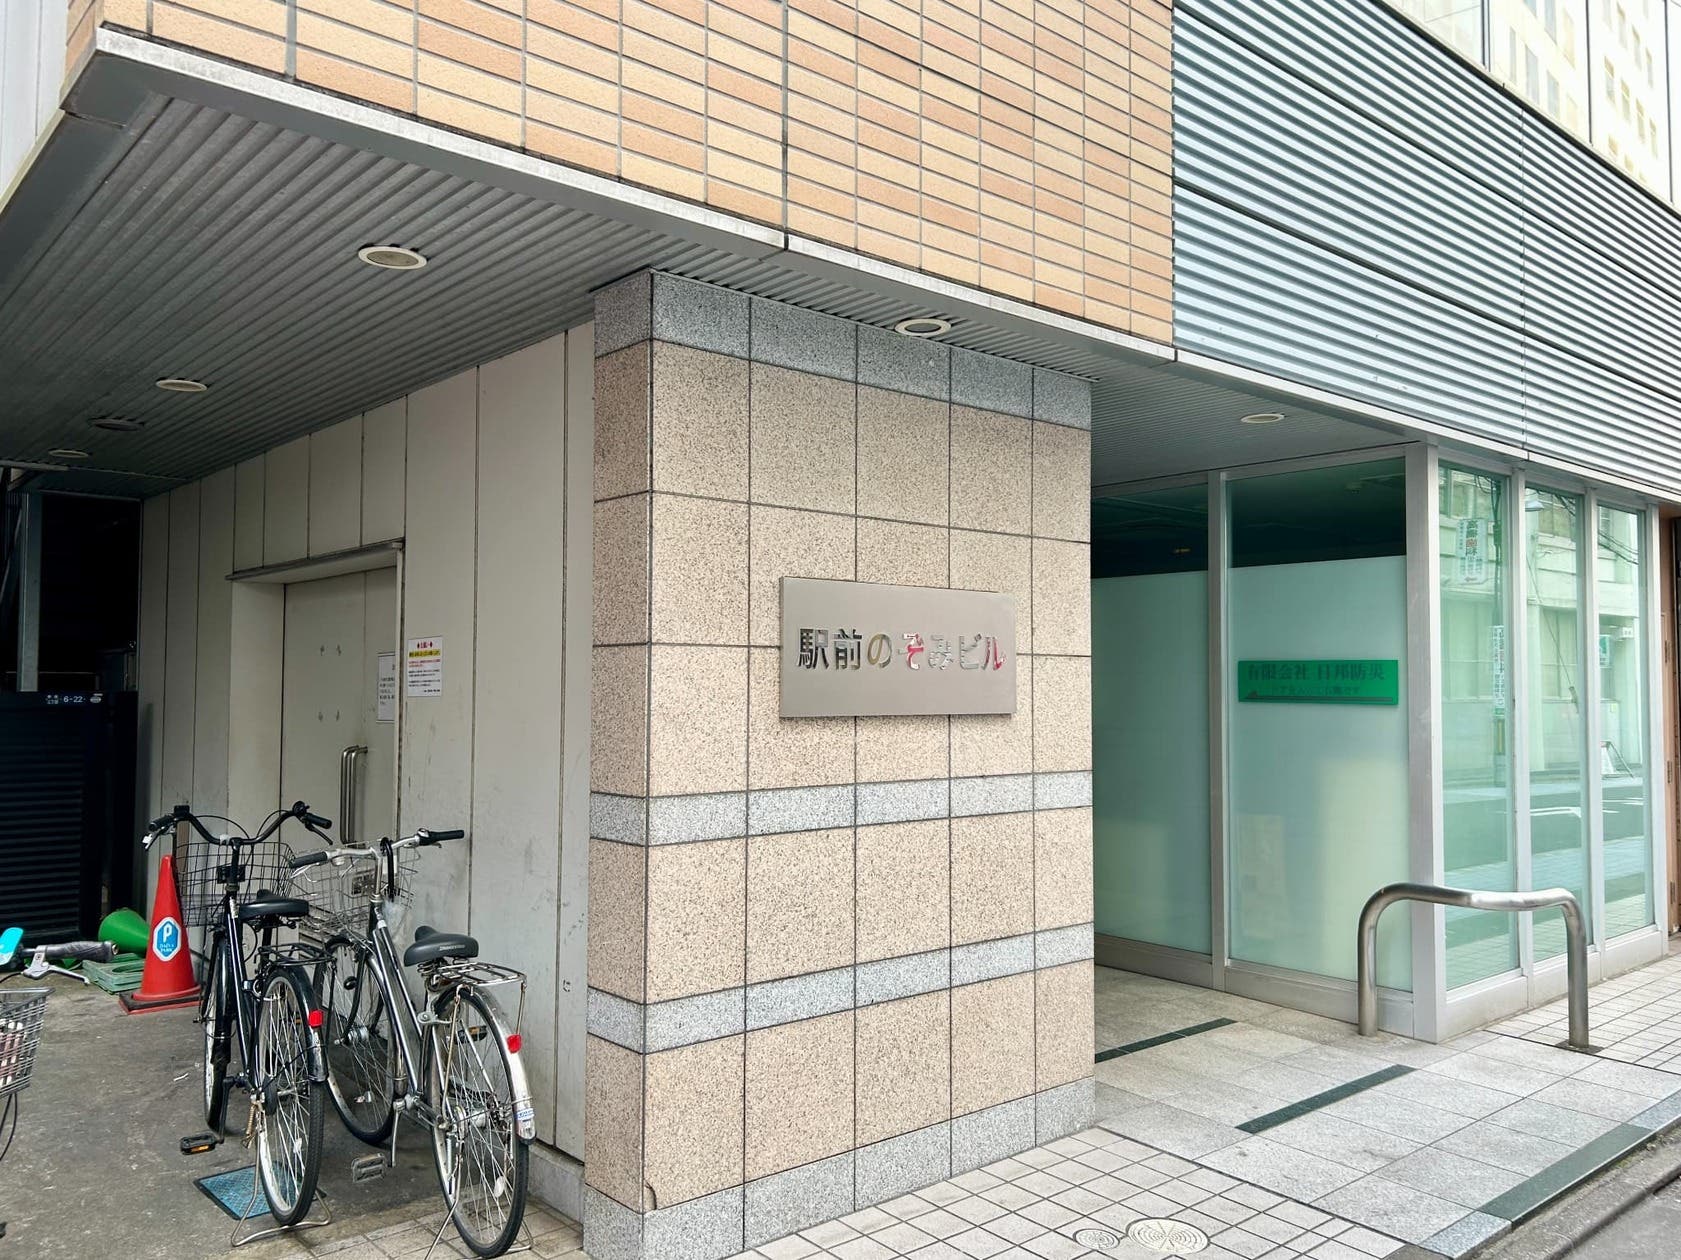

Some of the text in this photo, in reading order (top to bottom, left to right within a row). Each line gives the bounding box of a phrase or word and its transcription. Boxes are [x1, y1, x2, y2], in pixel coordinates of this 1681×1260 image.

[796, 628, 1008, 671] 駅前のぞみビル
[1247, 663, 1307, 681] 有限会社
